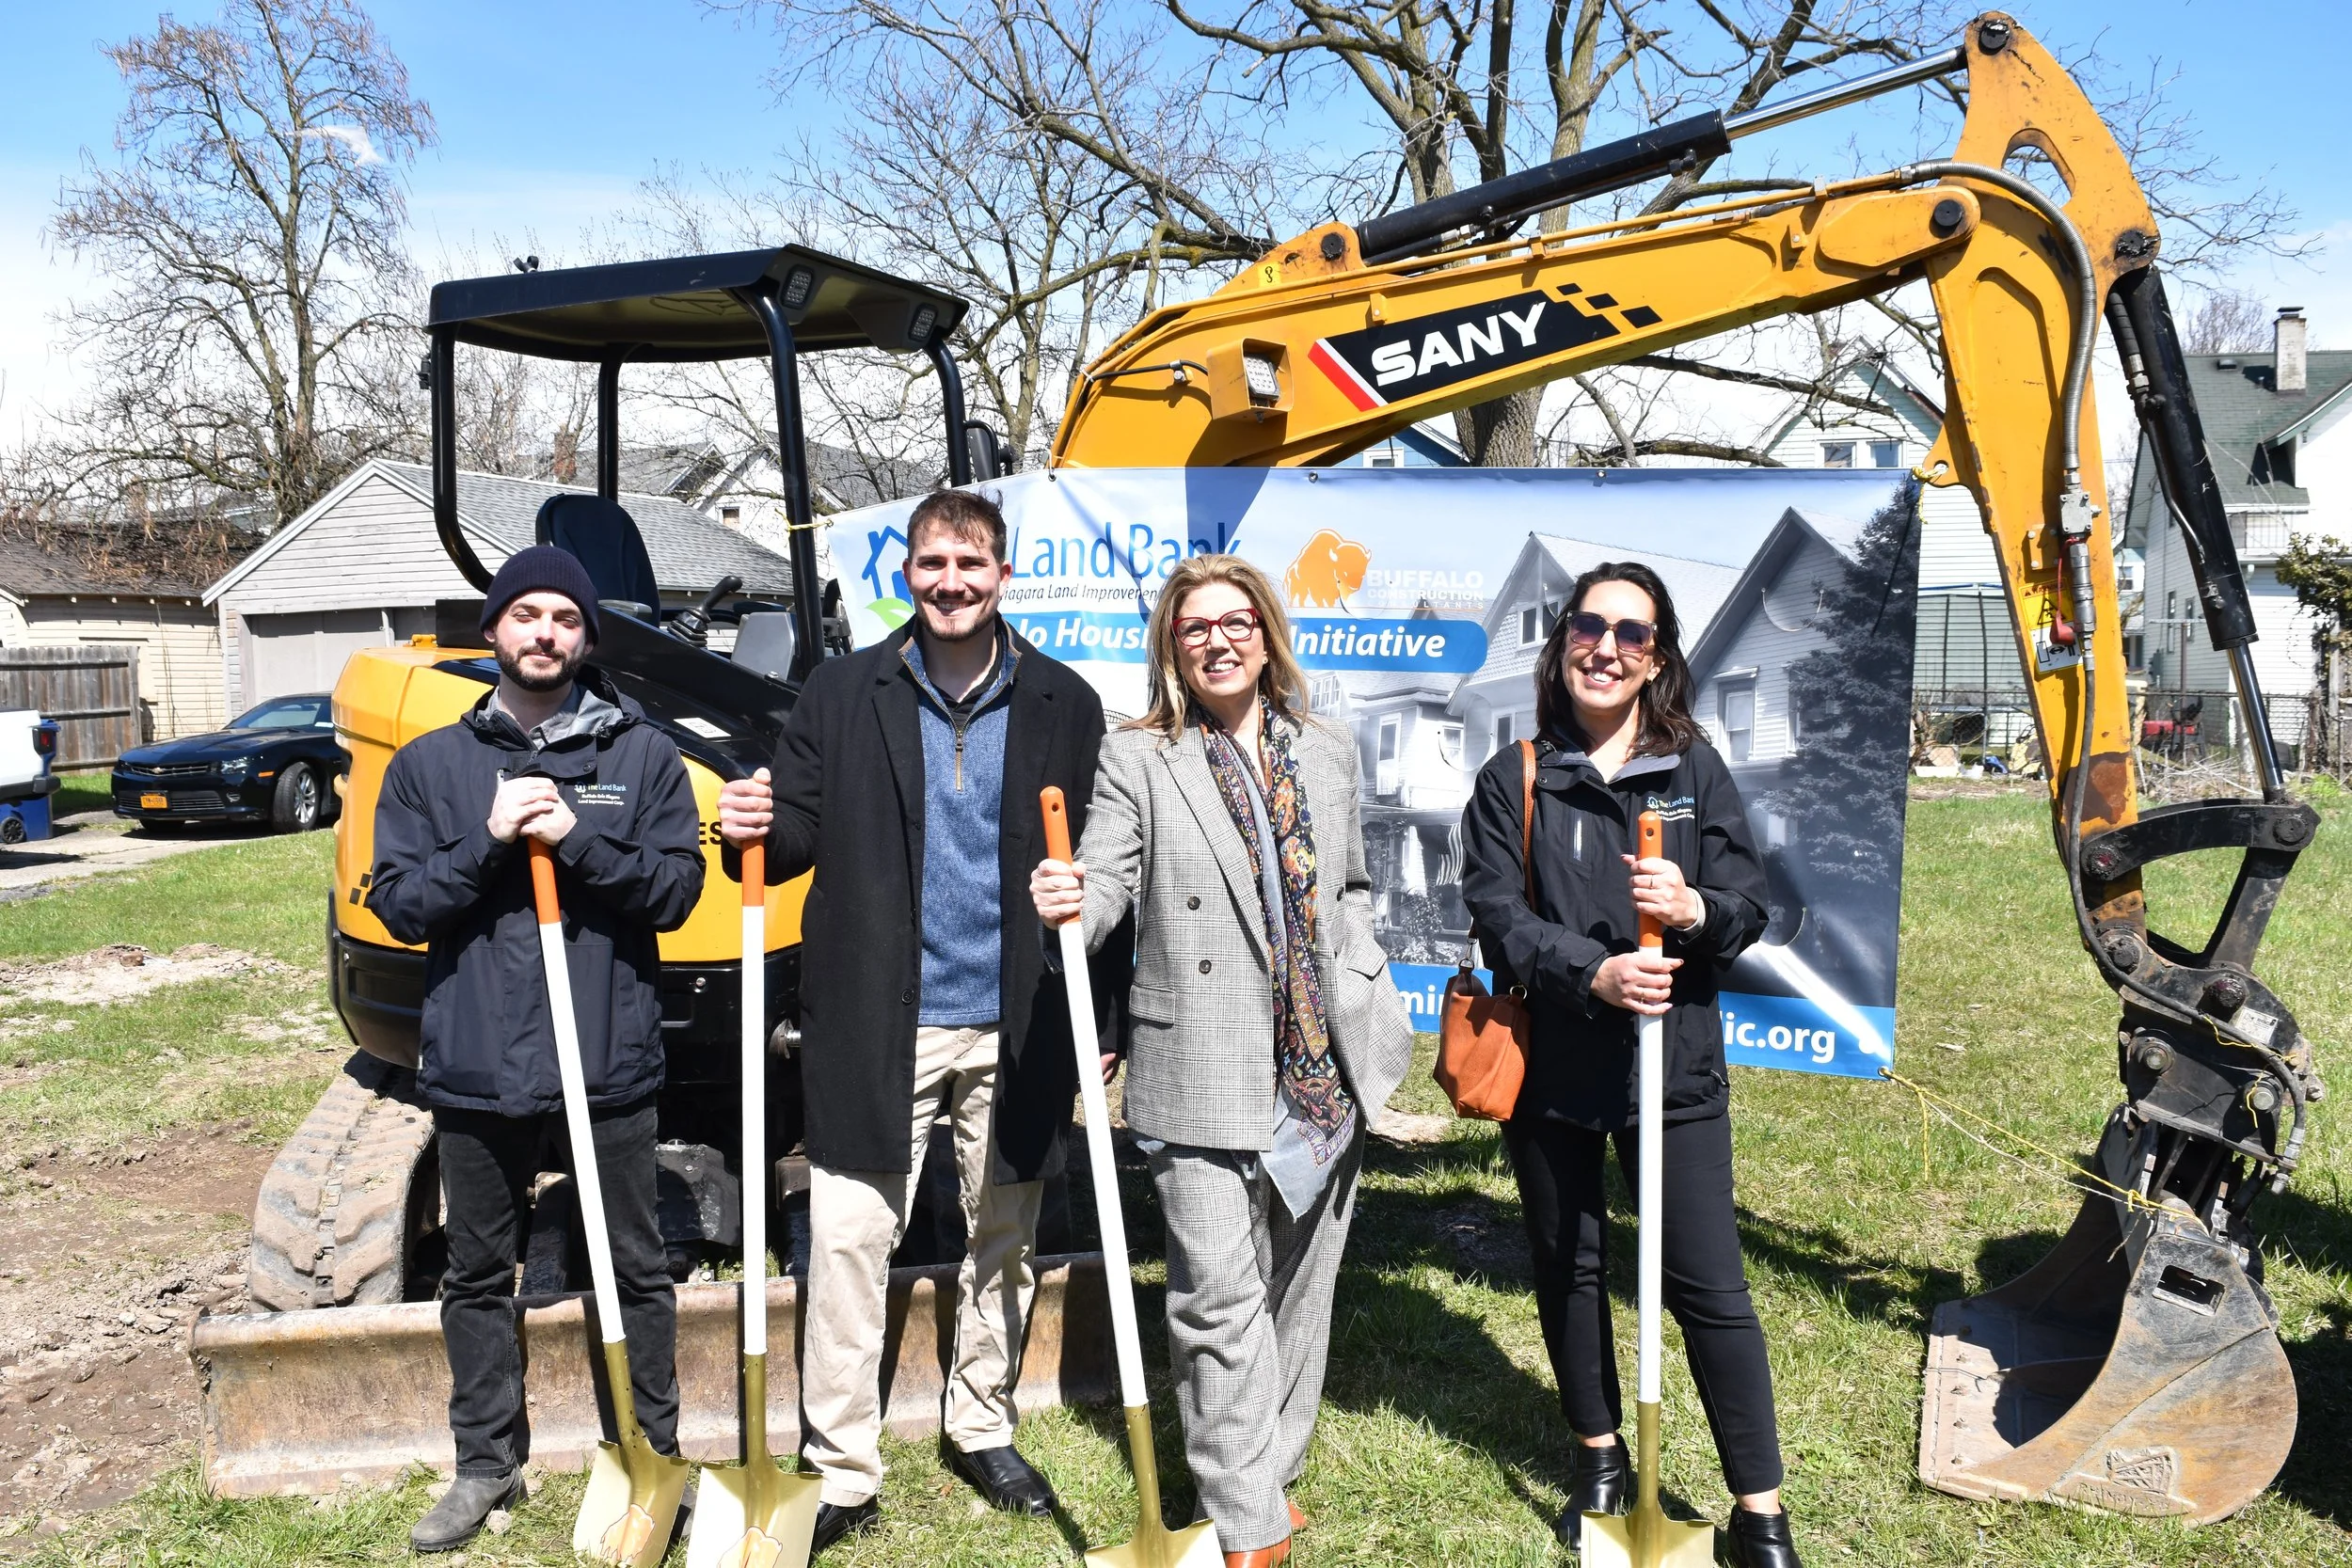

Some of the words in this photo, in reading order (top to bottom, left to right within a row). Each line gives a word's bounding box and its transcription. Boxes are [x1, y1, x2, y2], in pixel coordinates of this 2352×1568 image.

[1372, 301, 1547, 387] SANY
[1011, 521, 1115, 578] Land
[1367, 569, 1484, 589] BUFFALO
[1000, 586, 1045, 604] iagara
[1048, 583, 1079, 599] Land
[1367, 589, 1484, 601] CONSTRUCTION
[1290, 624, 1446, 657] Initiative
[612, 784, 627, 792] Bank
[1668, 798, 1682, 807] Land
[1720, 1010, 1836, 1064] ic.org
